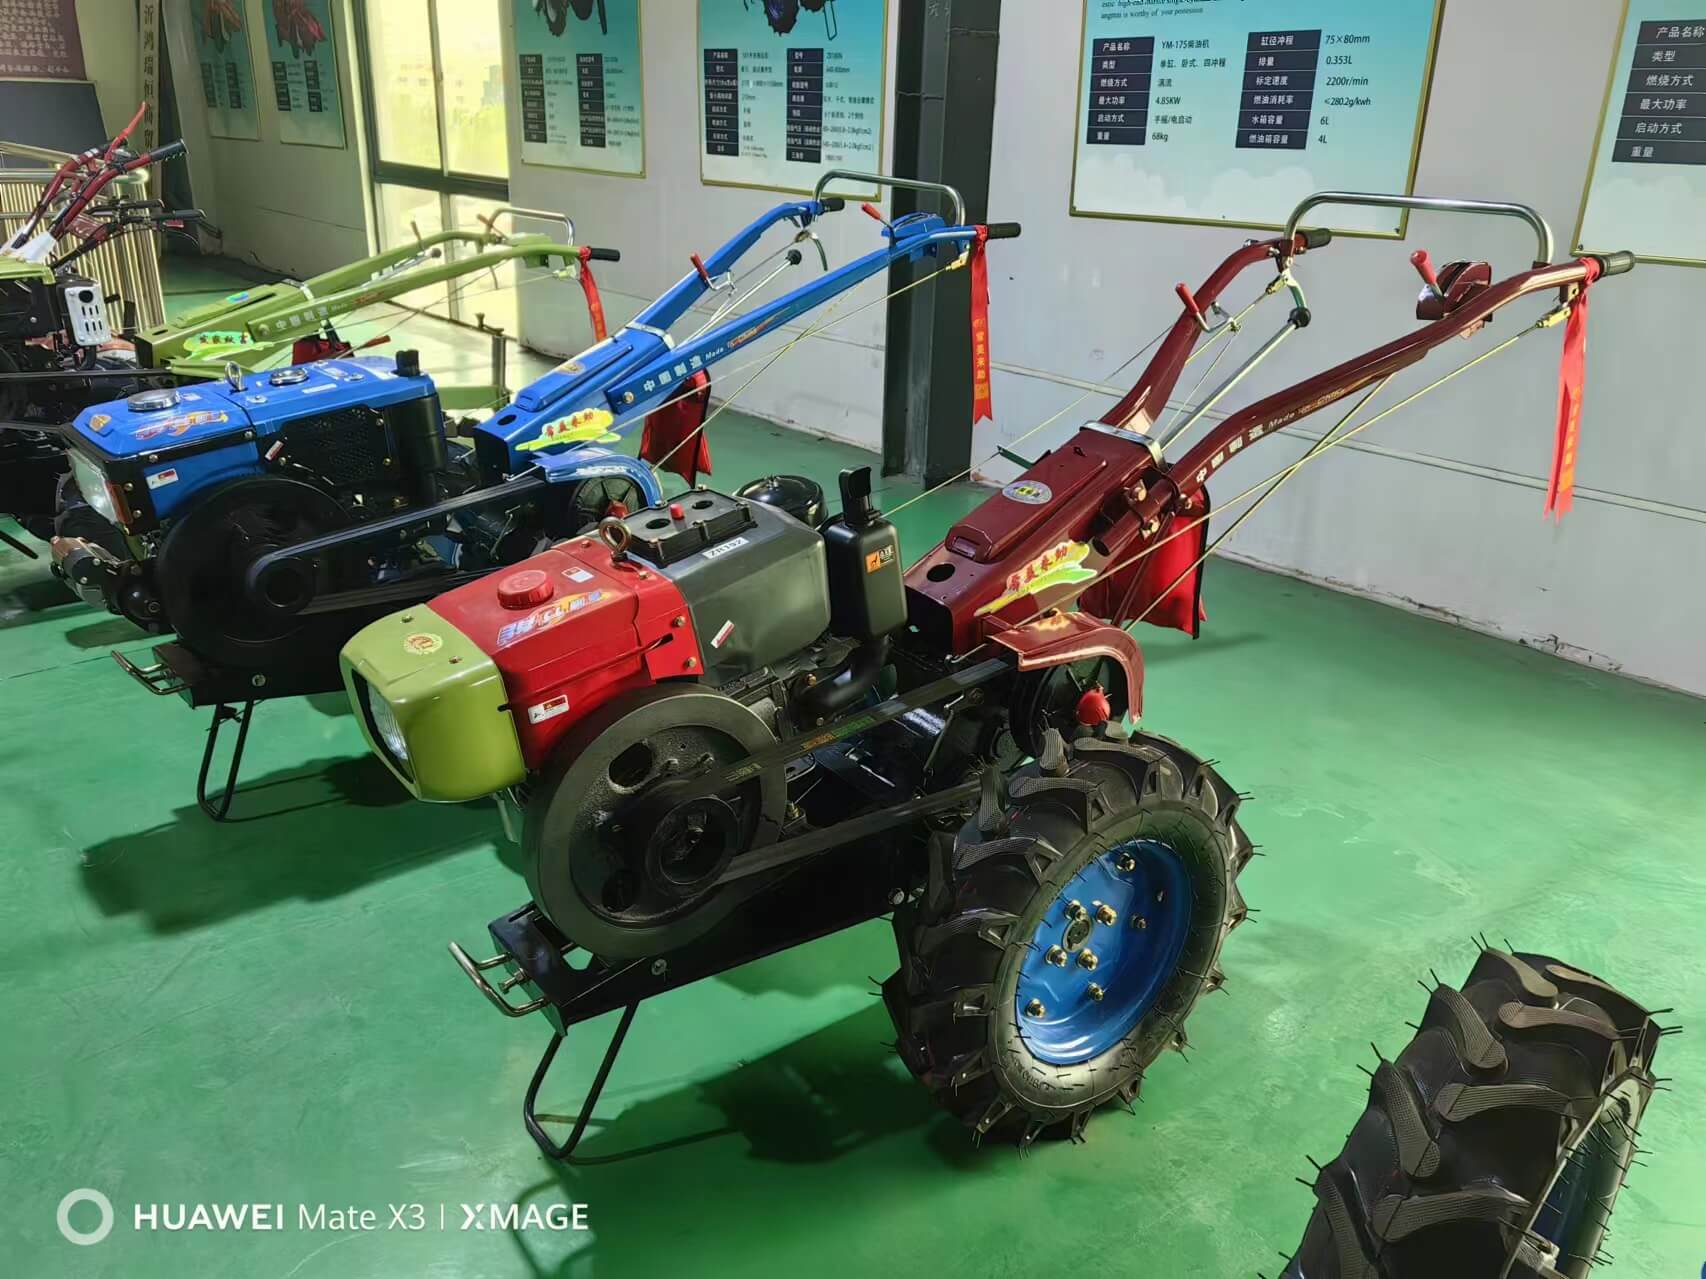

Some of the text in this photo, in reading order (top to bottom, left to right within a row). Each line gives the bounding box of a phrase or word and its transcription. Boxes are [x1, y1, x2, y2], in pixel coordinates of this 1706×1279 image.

[1655, 26, 1705, 39] 产品名称
[1102, 42, 1131, 52] 产品名称
[1258, 56, 1275, 67] 排量
[1326, 56, 1353, 65] 0.353L
[1651, 50, 1676, 62] 类型
[1325, 76, 1369, 87] 2200r/min
[1645, 74, 1694, 87] 燃烧方式
[1098, 96, 1126, 105] 最大功率
[1155, 96, 1181, 105] 4.85KW
[1639, 98, 1688, 111] 最大功率
[1319, 116, 1329, 126] 6L
[1634, 122, 1683, 135] 启动方式
[1152, 132, 1169, 142] 68kg
[1318, 134, 1328, 144] 4L
[1630, 146, 1654, 158] 重量
[1268, 411, 1295, 429] Made
